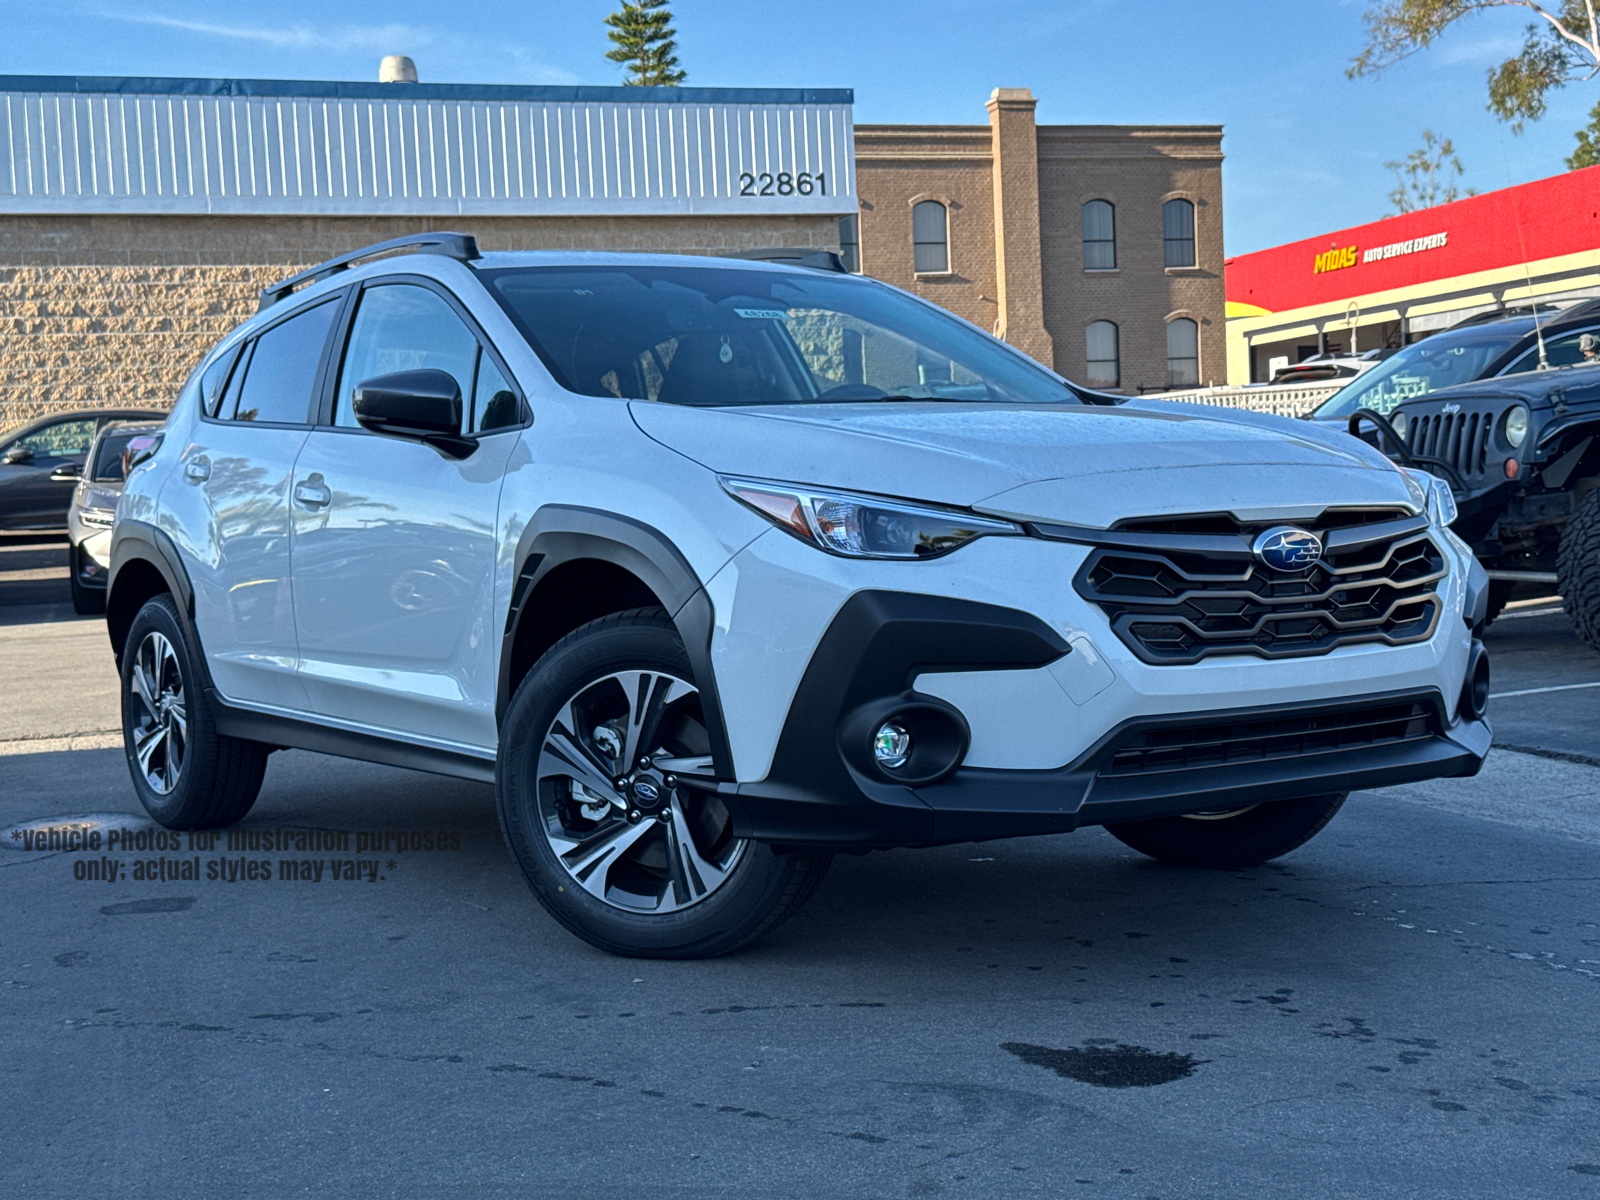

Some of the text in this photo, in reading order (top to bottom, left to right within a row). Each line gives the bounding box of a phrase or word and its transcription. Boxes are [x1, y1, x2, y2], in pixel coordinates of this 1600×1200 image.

[739, 171, 826, 197] 22861
[1363, 247, 1384, 263] AUTO
[1383, 240, 1414, 259] SERVICE
[1413, 232, 1448, 252] EXPERTS
[1441, 402, 1461, 415] Jeep
[507, 774, 541, 880] YOKOHAMA
